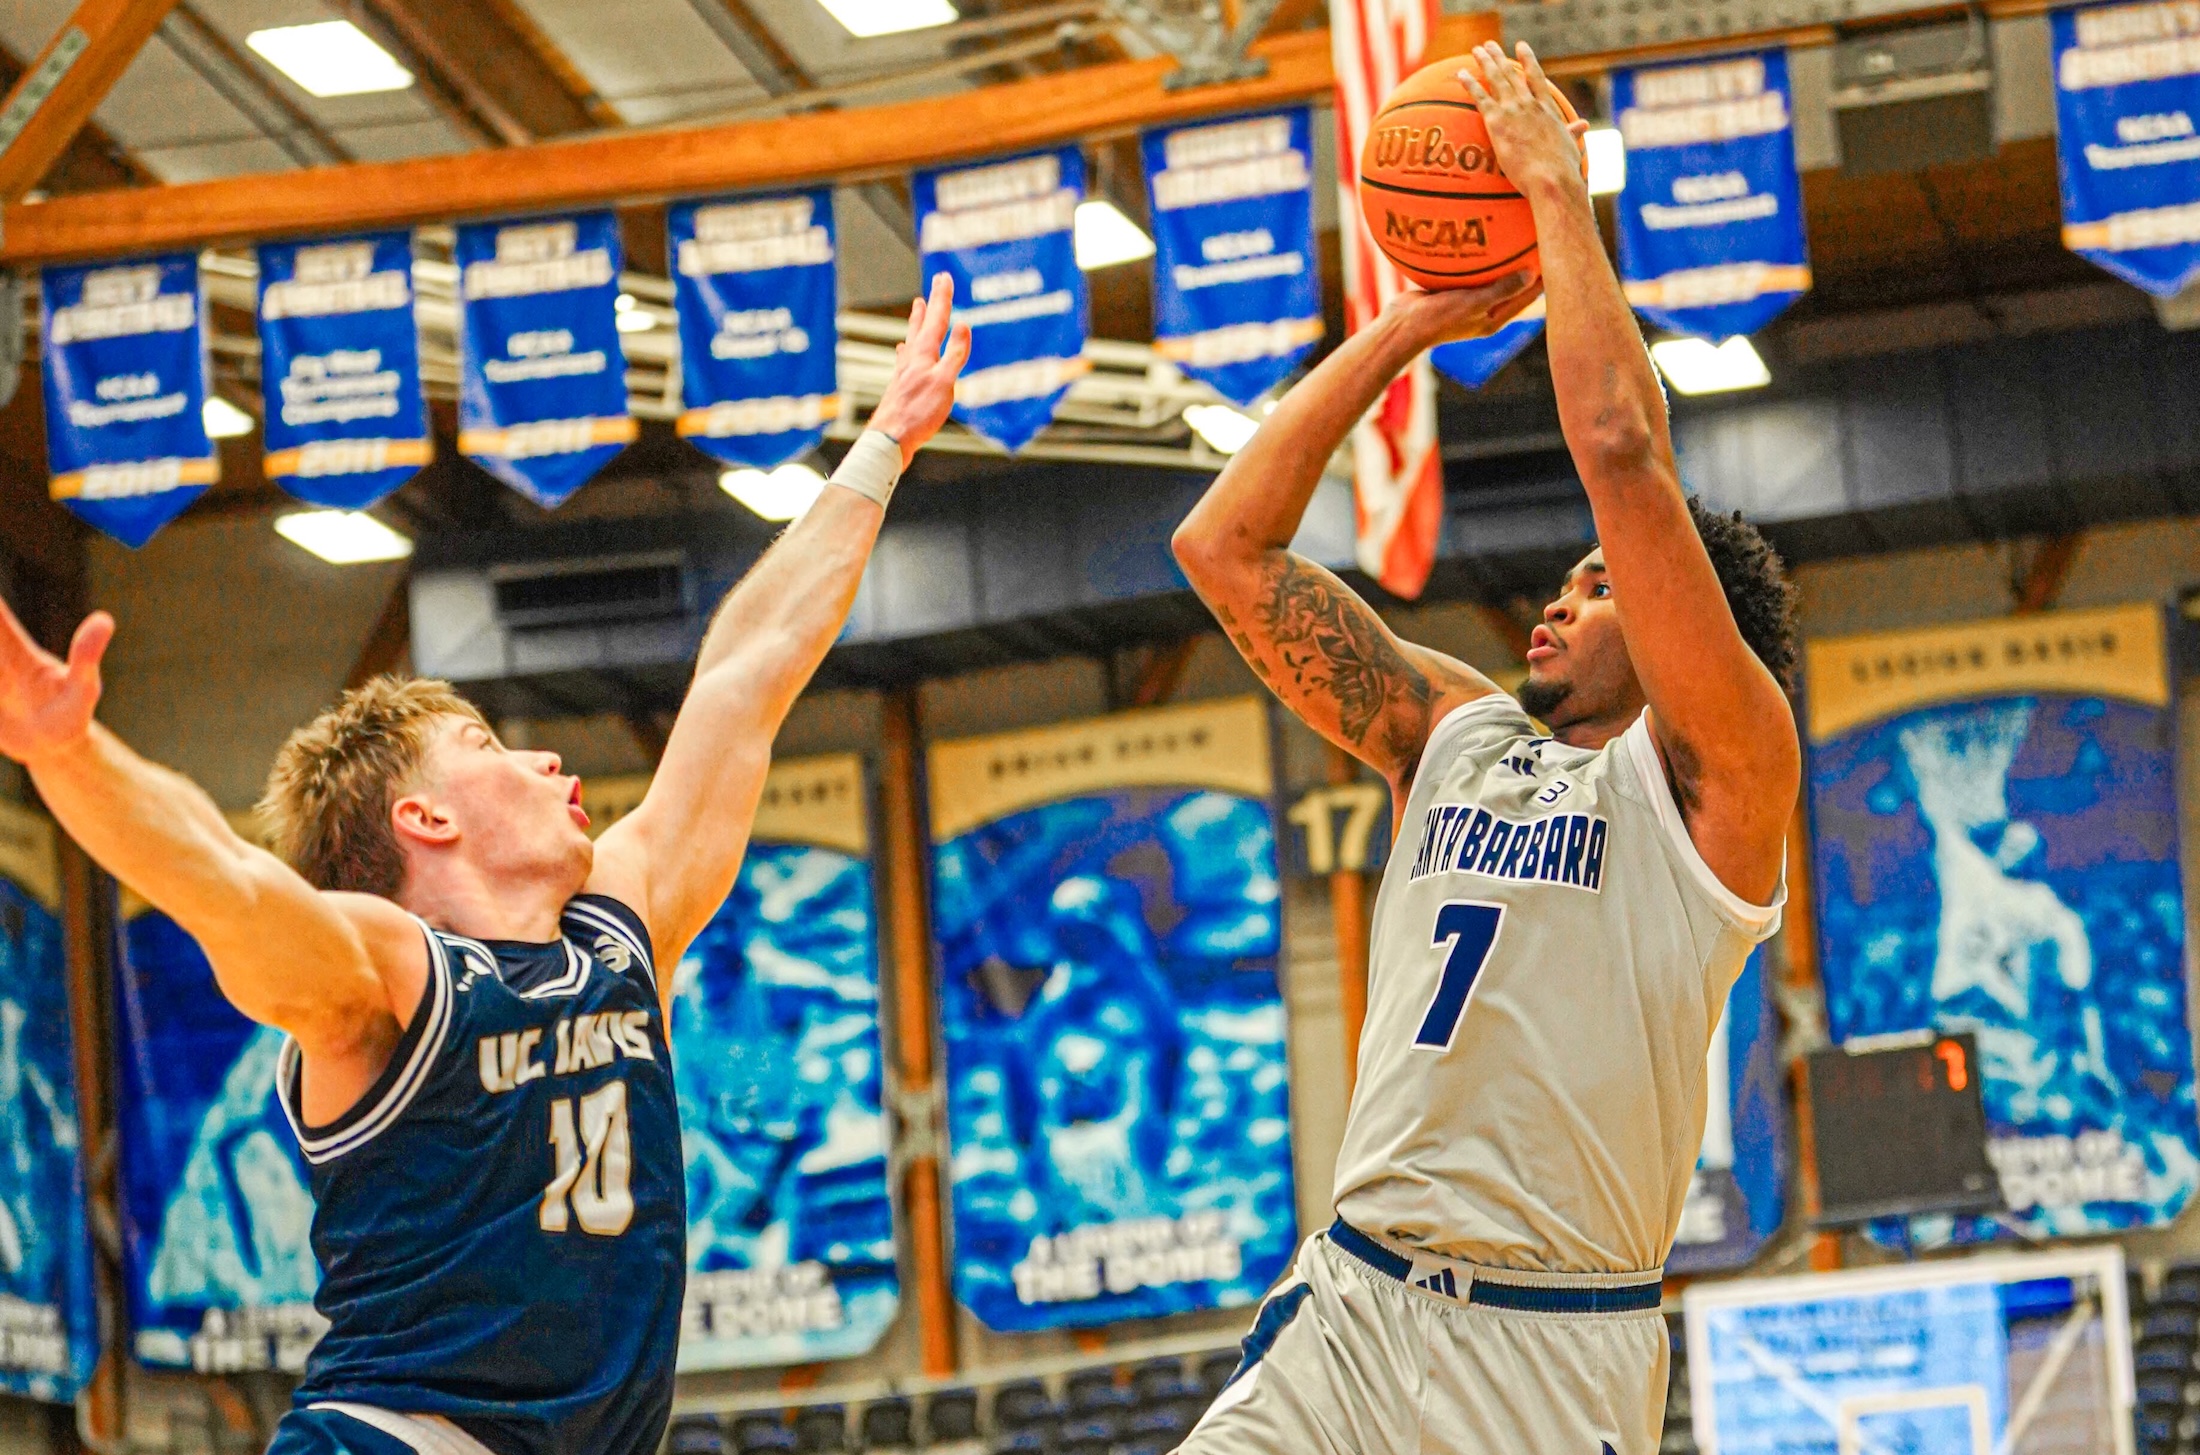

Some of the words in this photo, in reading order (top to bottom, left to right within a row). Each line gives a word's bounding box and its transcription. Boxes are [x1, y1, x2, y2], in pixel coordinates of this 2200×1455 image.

[1385, 208, 1486, 249] NCAA
[1287, 782, 1385, 875] 17
[1453, 803, 1608, 894] BARBARA
[1410, 899, 1507, 1053] 7
[478, 1028, 546, 1094] UC
[539, 1080, 635, 1237] 10
